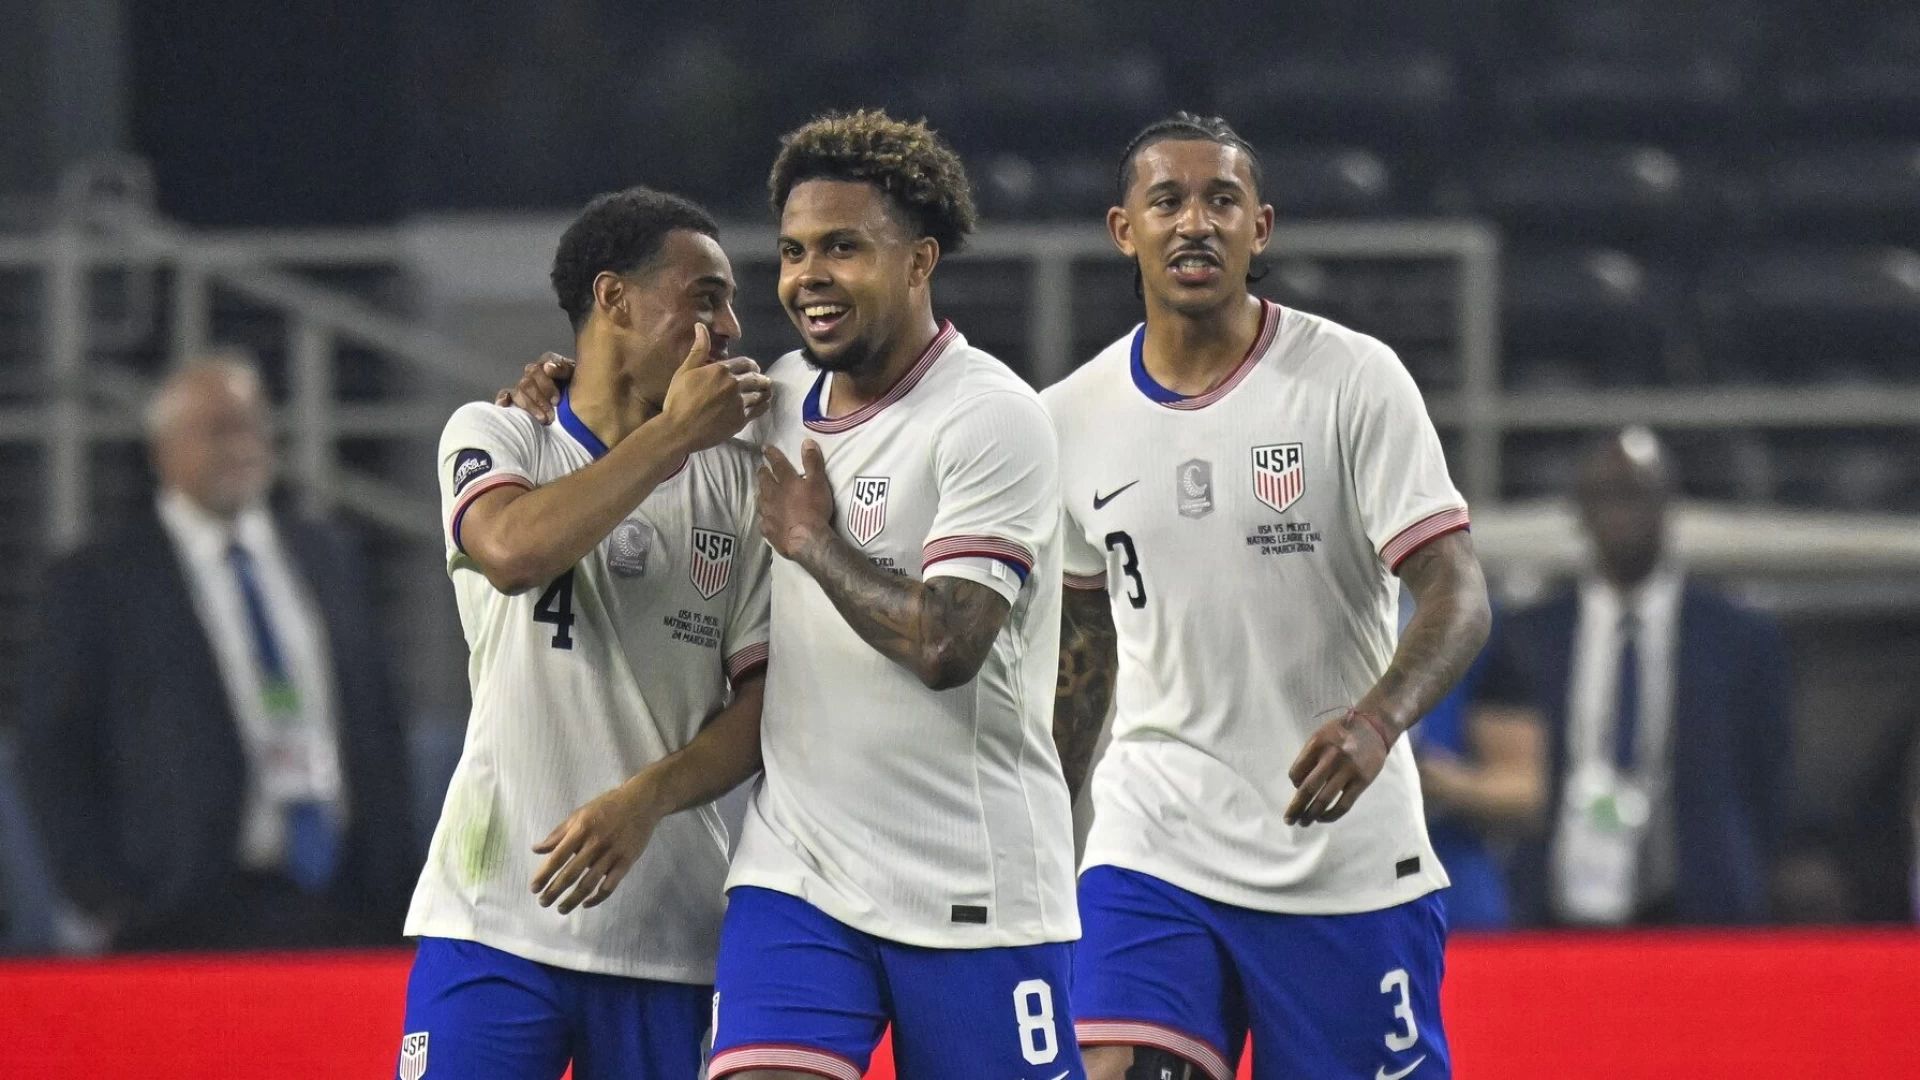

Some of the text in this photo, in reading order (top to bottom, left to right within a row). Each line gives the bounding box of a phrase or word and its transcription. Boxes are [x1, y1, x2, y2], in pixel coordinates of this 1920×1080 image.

[1256, 448, 1298, 472] USA
[856, 481, 886, 505] USA
[1246, 536, 1276, 545] NATIONS
[1278, 533, 1303, 543] LEAGUE
[1257, 525, 1272, 534] USA
[1287, 522, 1311, 532] MEXICO
[696, 532, 732, 560] USA
[1261, 543, 1315, 555] 24 MARCH 2024
[1105, 530, 1147, 609] 3
[533, 566, 575, 651] 4
[678, 609, 692, 620] USA
[663, 615, 692, 632] NATIONS
[693, 623, 714, 637] LEAGUE
[671, 629, 682, 640] 24
[682, 632, 704, 646] MARCH
[1013, 978, 1059, 1066] 8
[1379, 968, 1419, 1053] 3
[404, 1035, 426, 1055] USA
